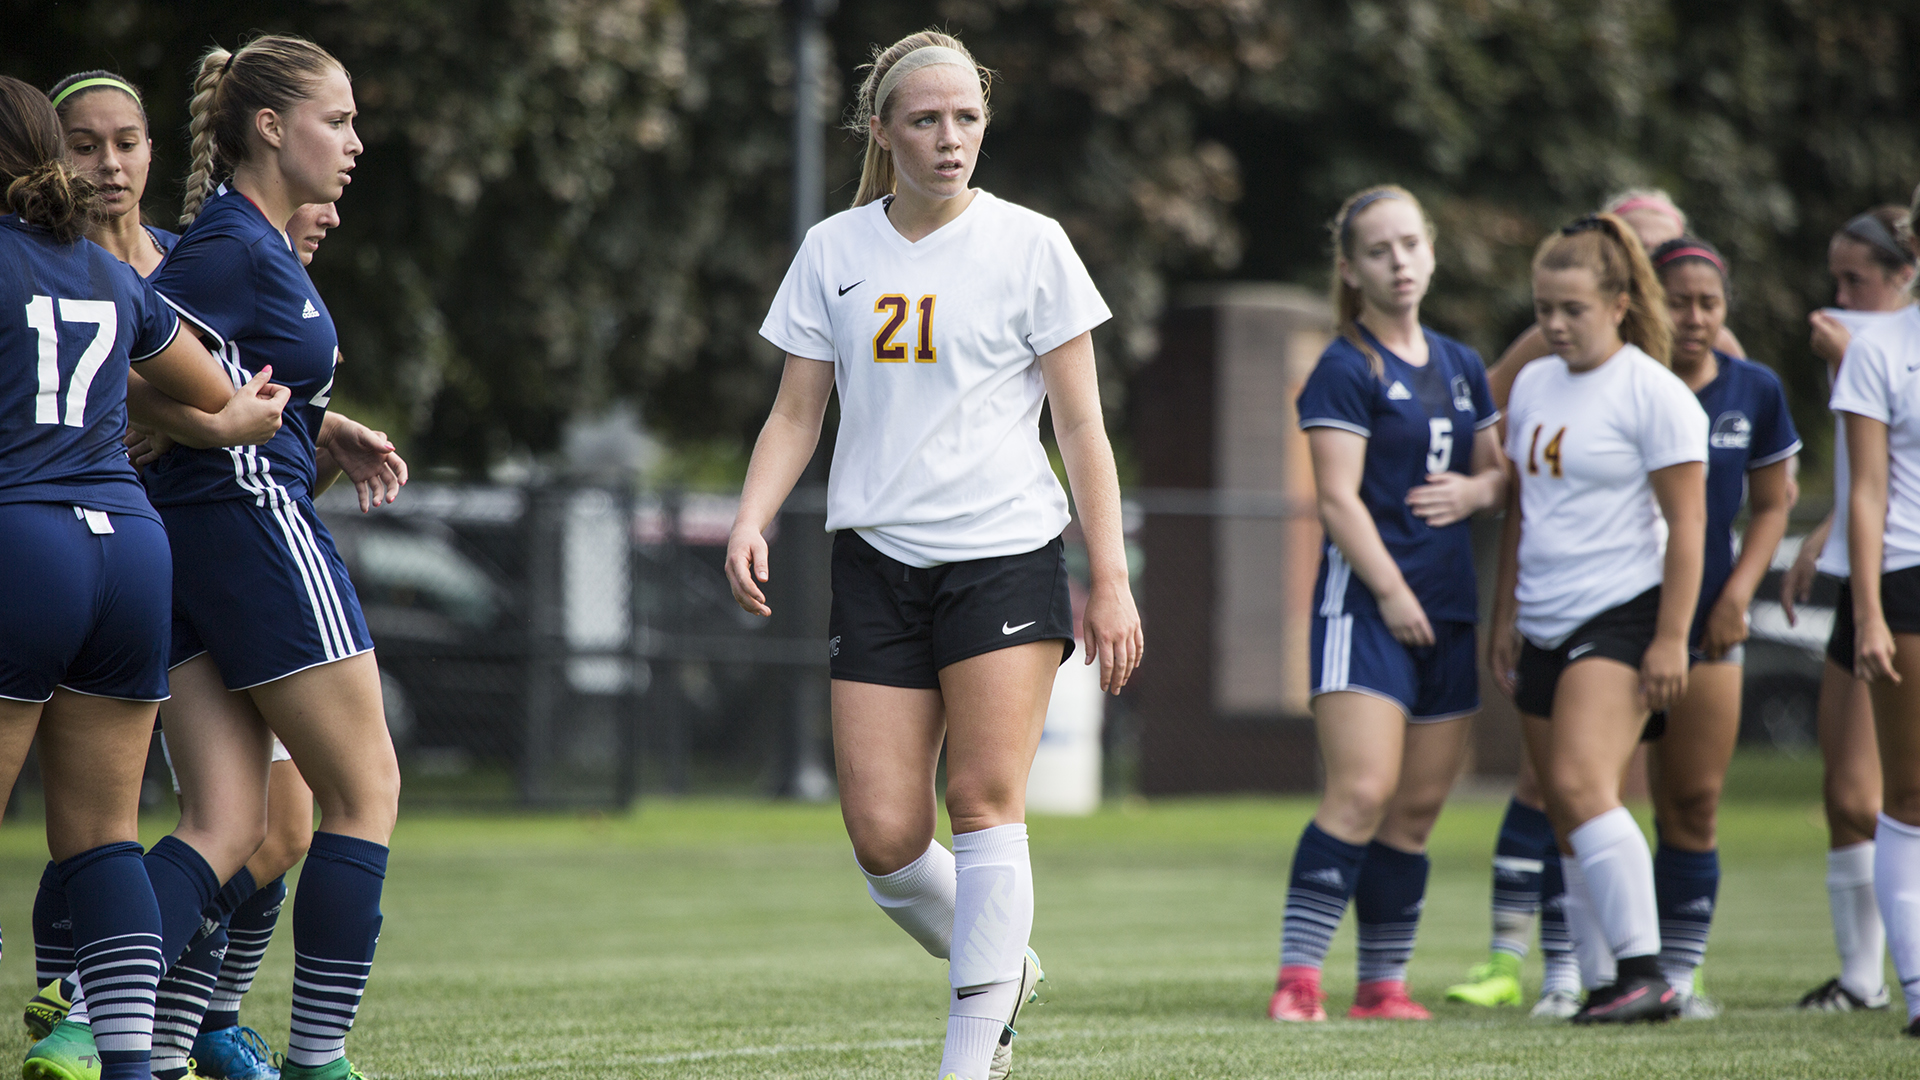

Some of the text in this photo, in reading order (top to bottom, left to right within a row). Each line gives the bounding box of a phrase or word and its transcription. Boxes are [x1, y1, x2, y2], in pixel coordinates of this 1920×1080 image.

[872, 293, 937, 363] 21
[25, 294, 116, 428] 17
[1426, 417, 1453, 474] 5
[1527, 424, 1566, 478] 14
